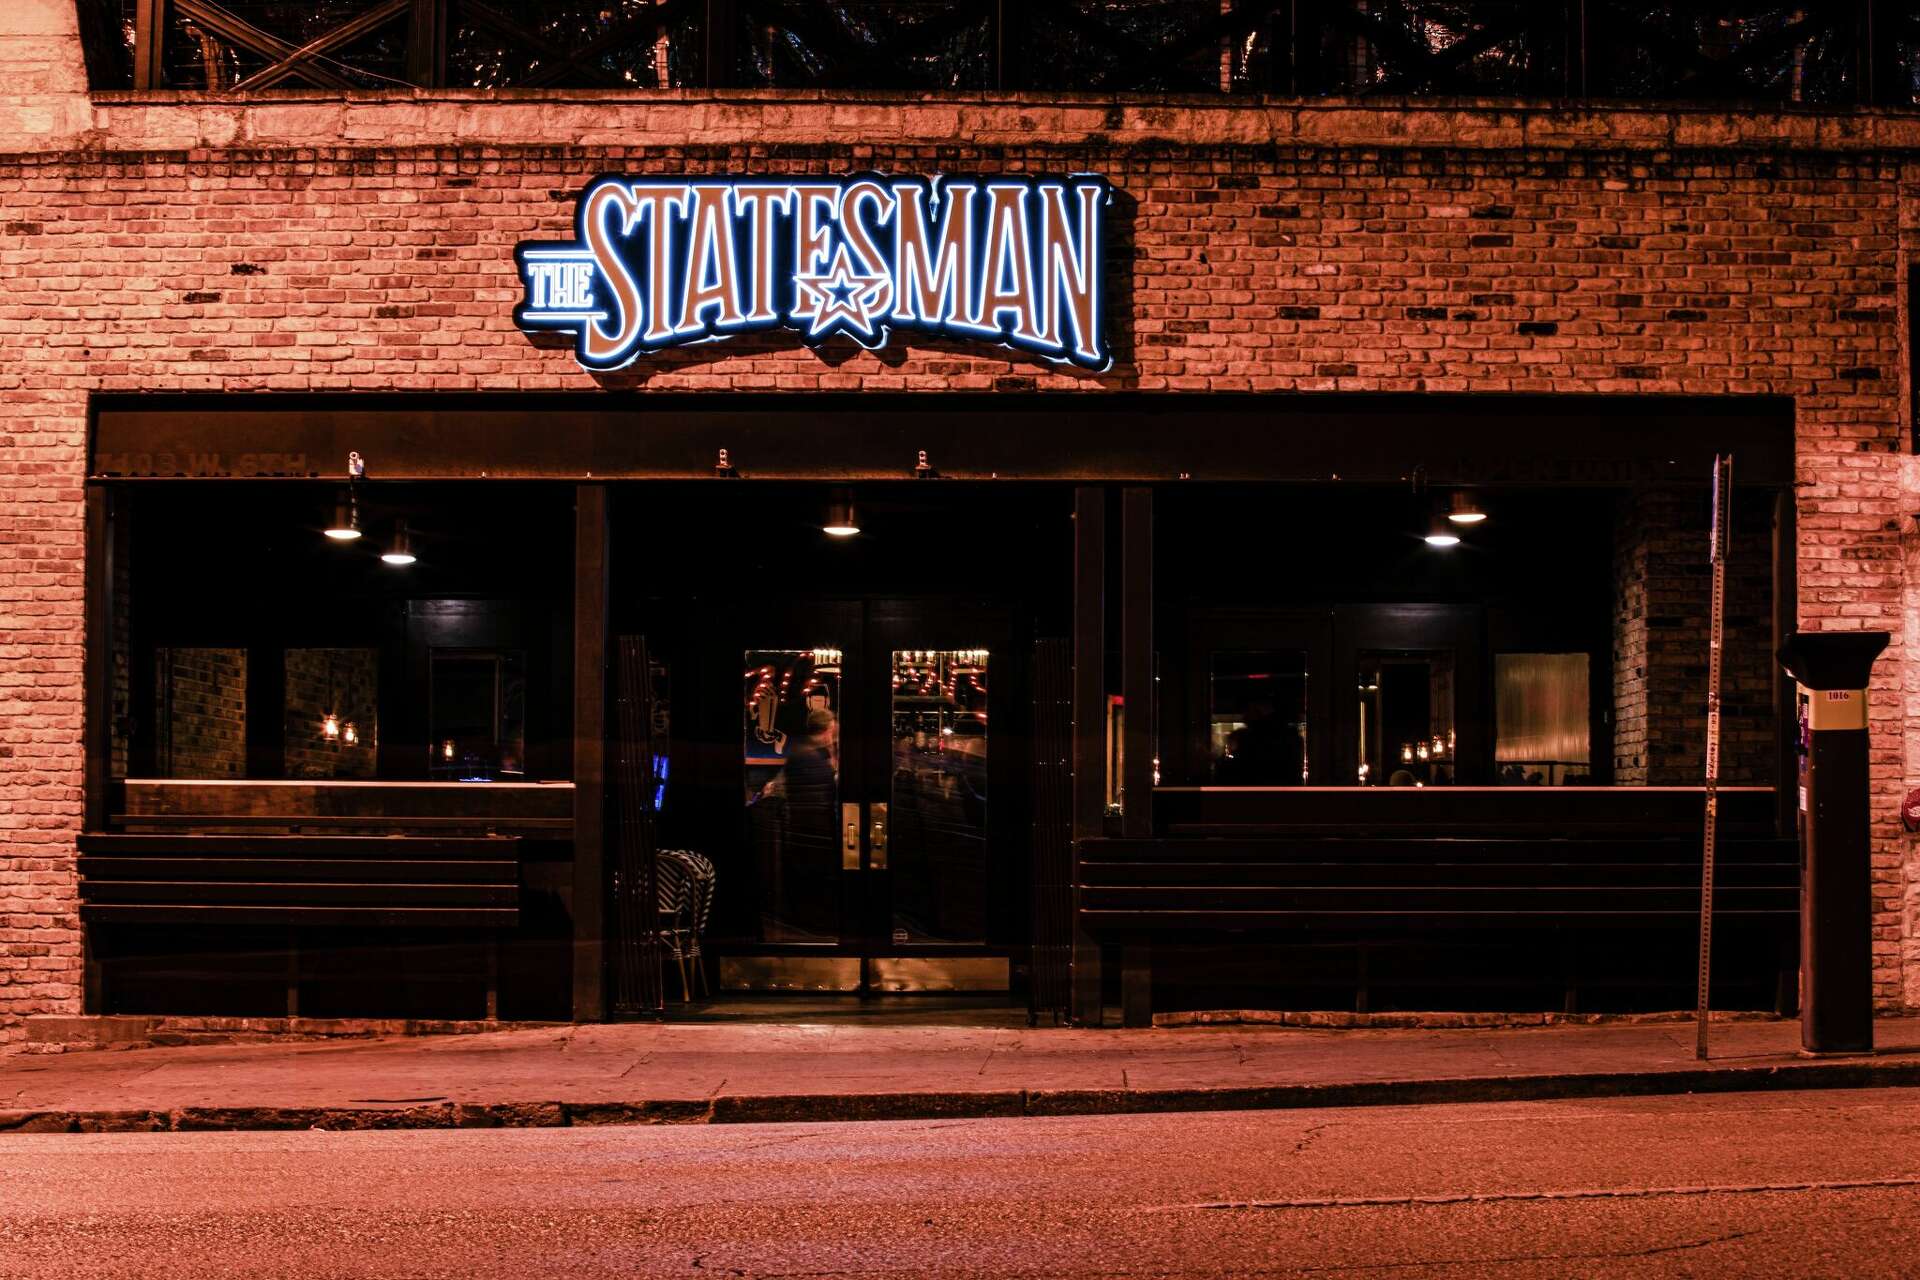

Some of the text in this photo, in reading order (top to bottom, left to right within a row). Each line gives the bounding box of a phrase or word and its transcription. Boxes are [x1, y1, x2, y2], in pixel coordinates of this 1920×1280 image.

[527, 263, 594, 308] THE
[585, 181, 1102, 359] STATESMAN
[1828, 691, 1849, 700] 1016
